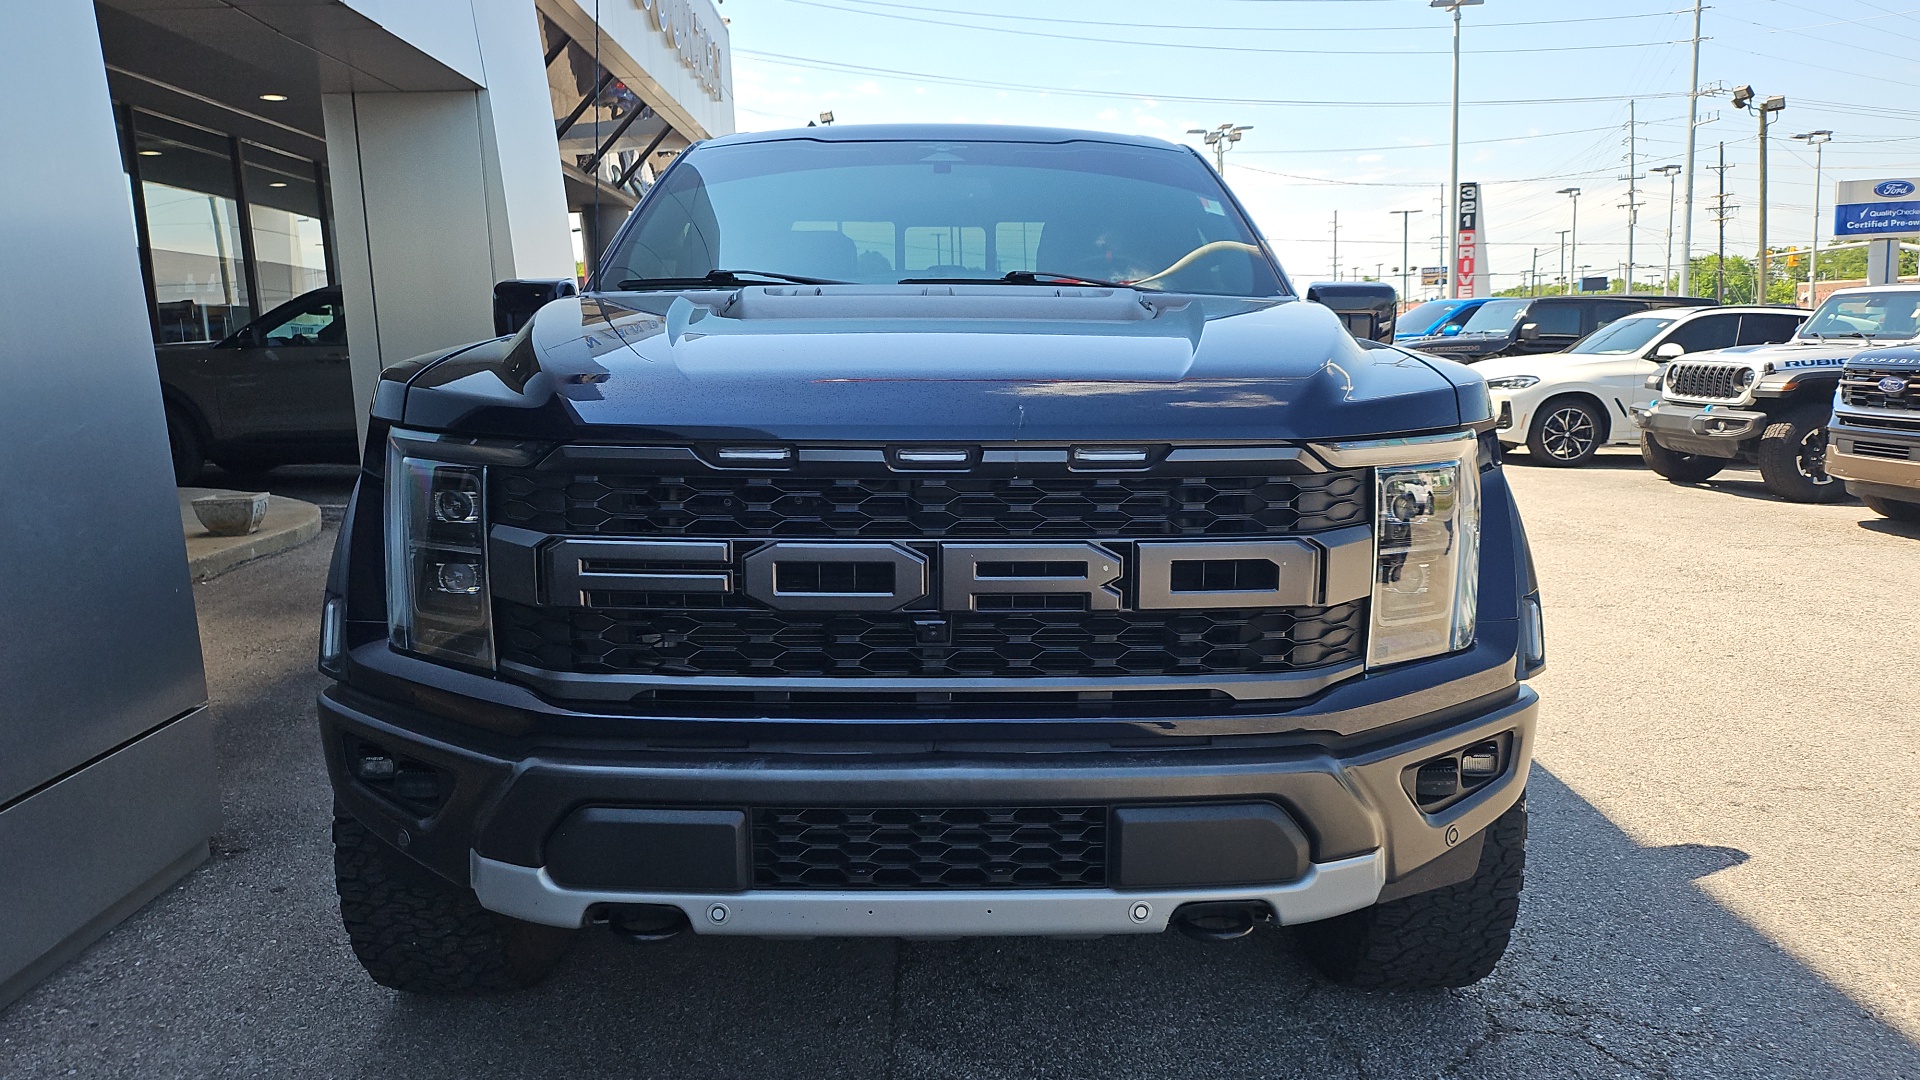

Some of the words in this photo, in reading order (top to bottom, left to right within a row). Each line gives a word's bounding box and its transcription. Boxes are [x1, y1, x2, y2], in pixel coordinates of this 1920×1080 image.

[1883, 183, 1908, 195] Ford
[1846, 219, 1889, 230] Certified
[1457, 232, 1475, 299] DRIVE
[544, 538, 1319, 612] FORD
